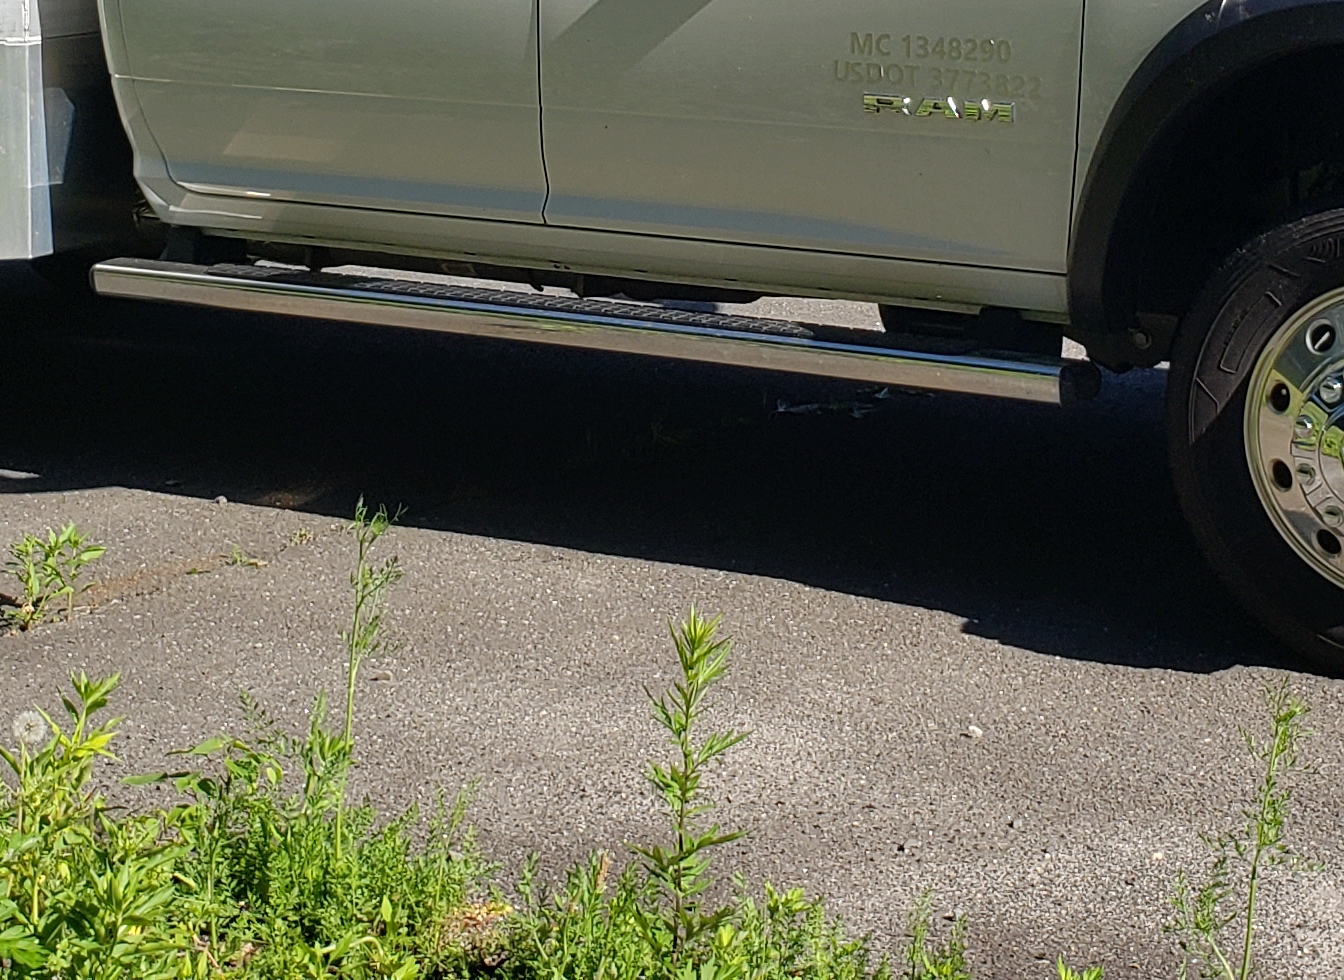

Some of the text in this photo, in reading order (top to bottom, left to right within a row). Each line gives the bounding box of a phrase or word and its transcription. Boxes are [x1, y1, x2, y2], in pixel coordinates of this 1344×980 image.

[850, 31, 1012, 65] MC 1348290
[833, 59, 920, 88] USDOT
[862, 91, 1016, 122] RAM
